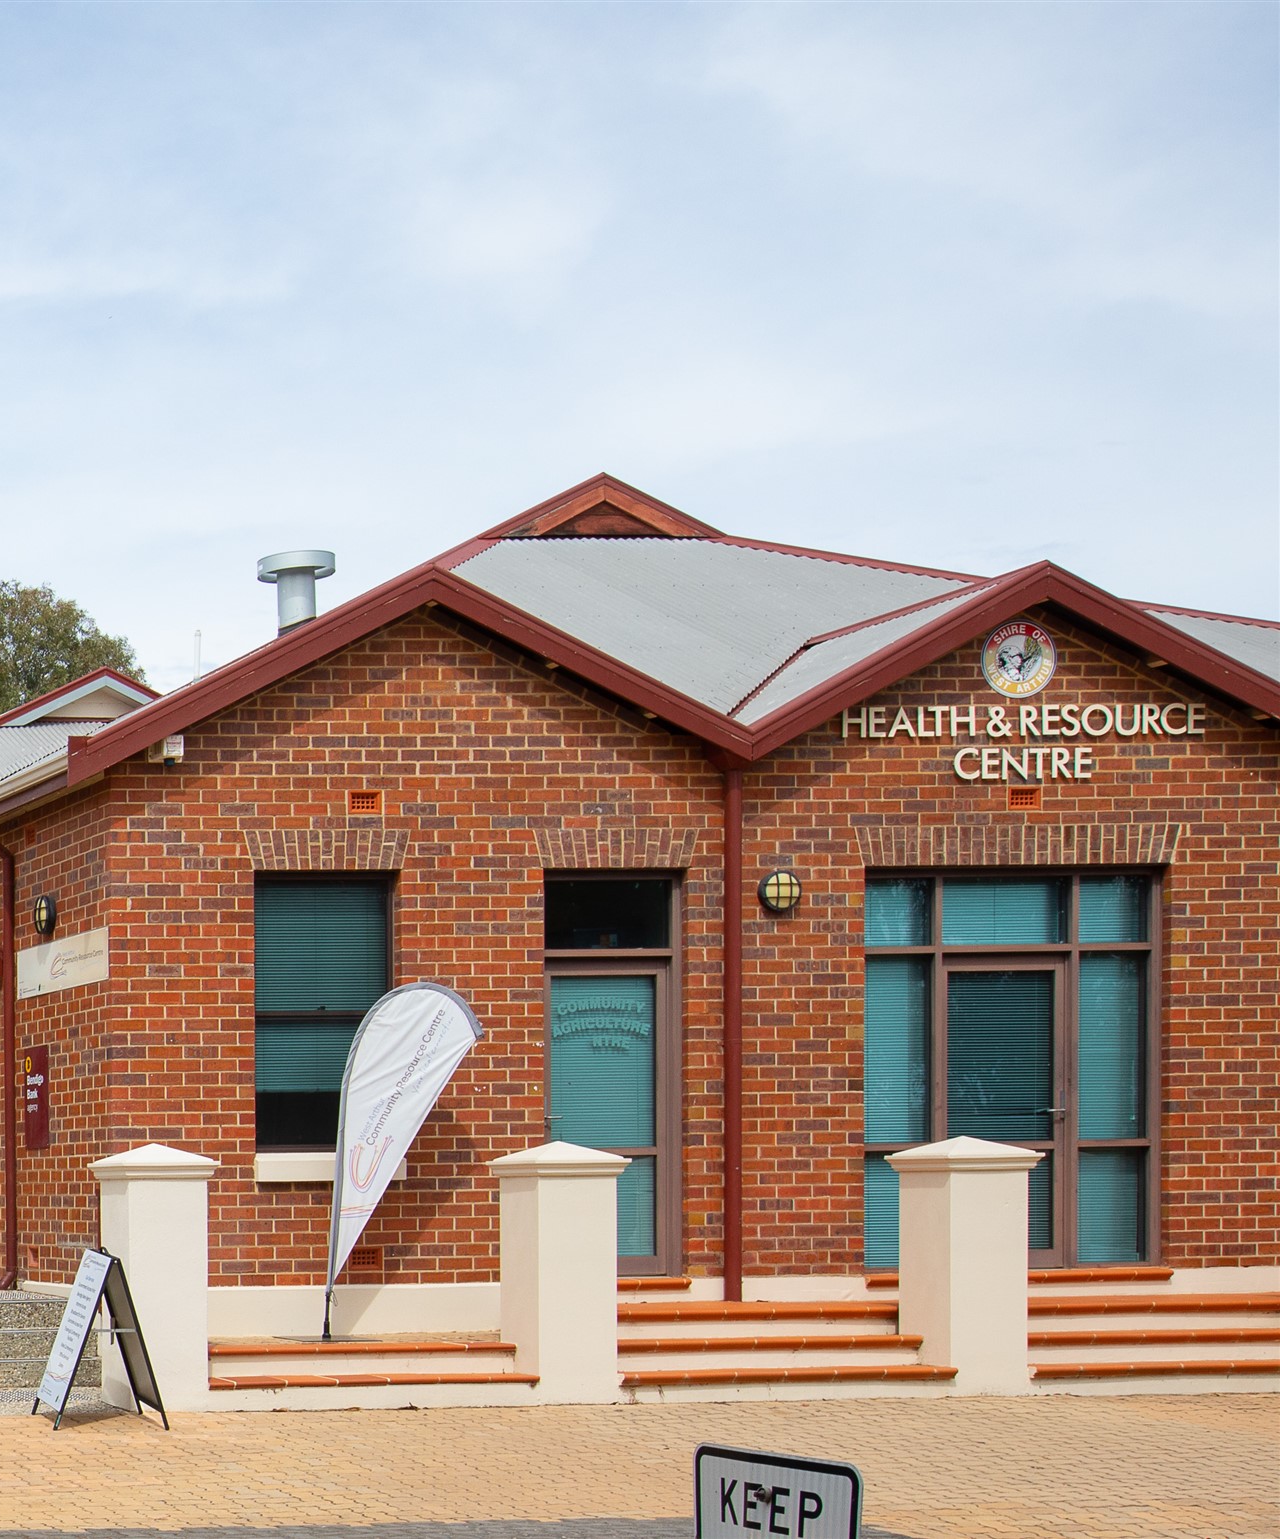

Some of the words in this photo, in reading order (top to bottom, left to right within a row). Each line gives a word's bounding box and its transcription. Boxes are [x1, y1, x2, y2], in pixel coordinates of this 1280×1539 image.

[993, 624, 1026, 645] SHIRE
[1032, 630, 1046, 643] OF
[987, 662, 1012, 690] WEST
[1016, 658, 1052, 693] ARTHUR
[842, 705, 976, 738] HEALTH
[986, 706, 1012, 738] &
[1020, 702, 1206, 737] RESOURCE
[953, 746, 1093, 781] CENTRE
[557, 996, 645, 1016] COMMUNITY
[552, 1016, 651, 1038] AGRICULTURE
[26, 1074, 44, 1086] Bendigo
[26, 1089, 38, 1100] Bank
[365, 1091, 402, 1146] Community
[396, 1044, 427, 1090] Resource
[422, 1009, 446, 1043] Centre
[357, 1120, 373, 1142] West
[369, 1097, 386, 1120] Arthur
[720, 1477, 823, 1539] KEEP
